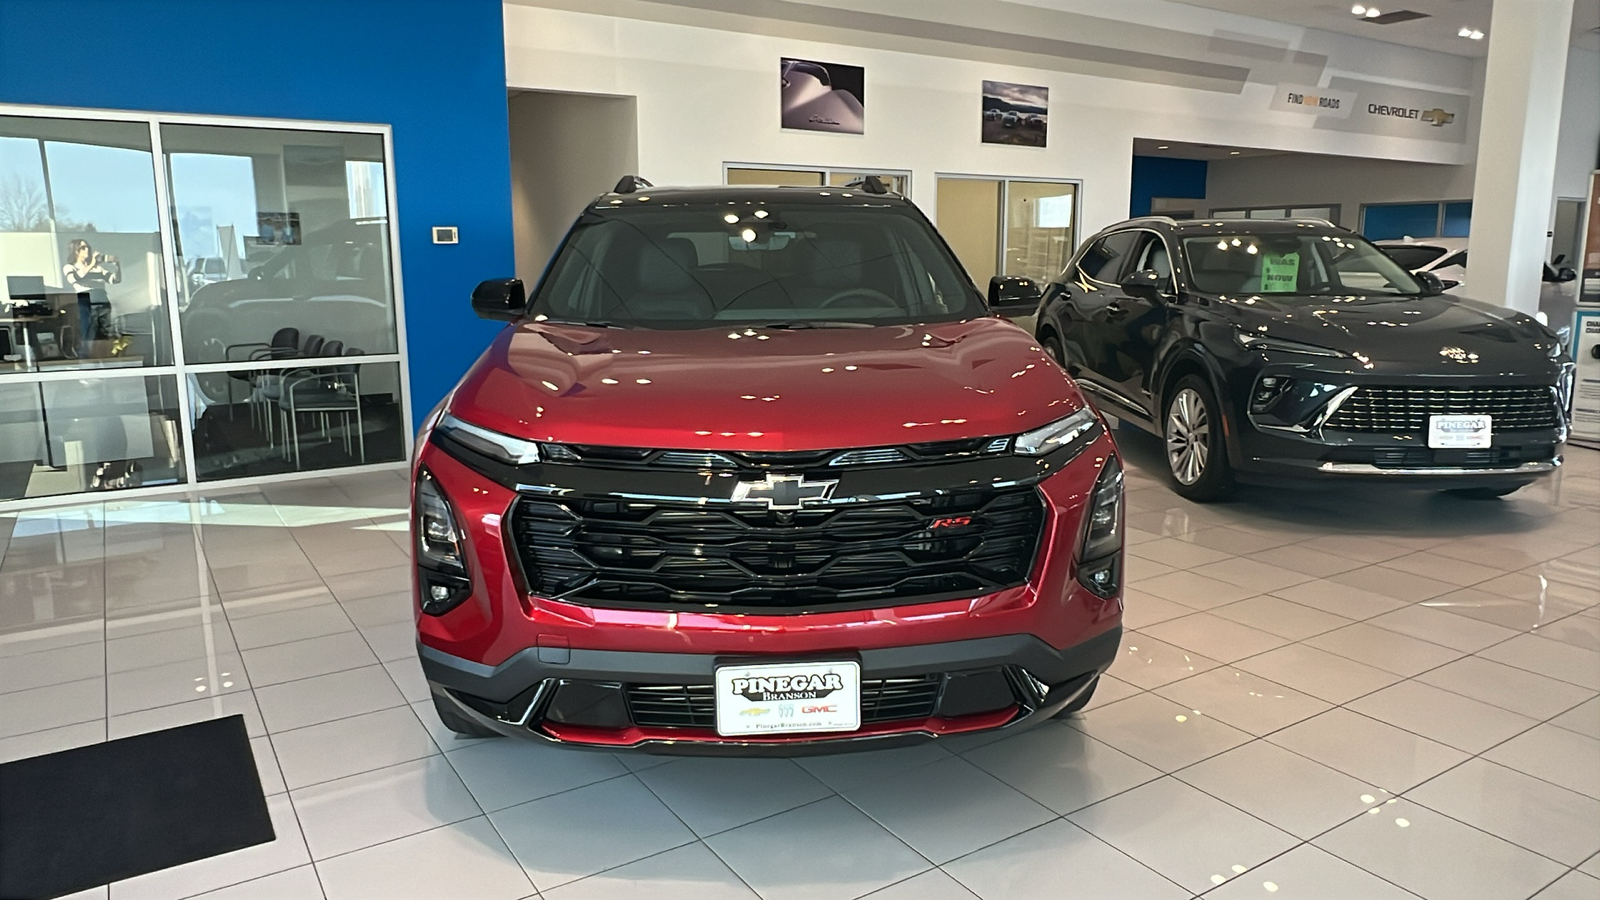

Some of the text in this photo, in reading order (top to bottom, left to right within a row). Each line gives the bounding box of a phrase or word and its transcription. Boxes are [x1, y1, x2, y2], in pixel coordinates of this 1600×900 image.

[1287, 92, 1304, 105] FIND
[1319, 96, 1340, 109] ROADS
[1368, 103, 1420, 119] CHEVROLET
[1266, 274, 1294, 282] NOW
[1436, 420, 1486, 430] PINEGAR
[931, 516, 972, 529] RS
[732, 673, 843, 695] PINEGAR
[763, 691, 816, 701] BRANSON
[801, 704, 838, 714] GMC
